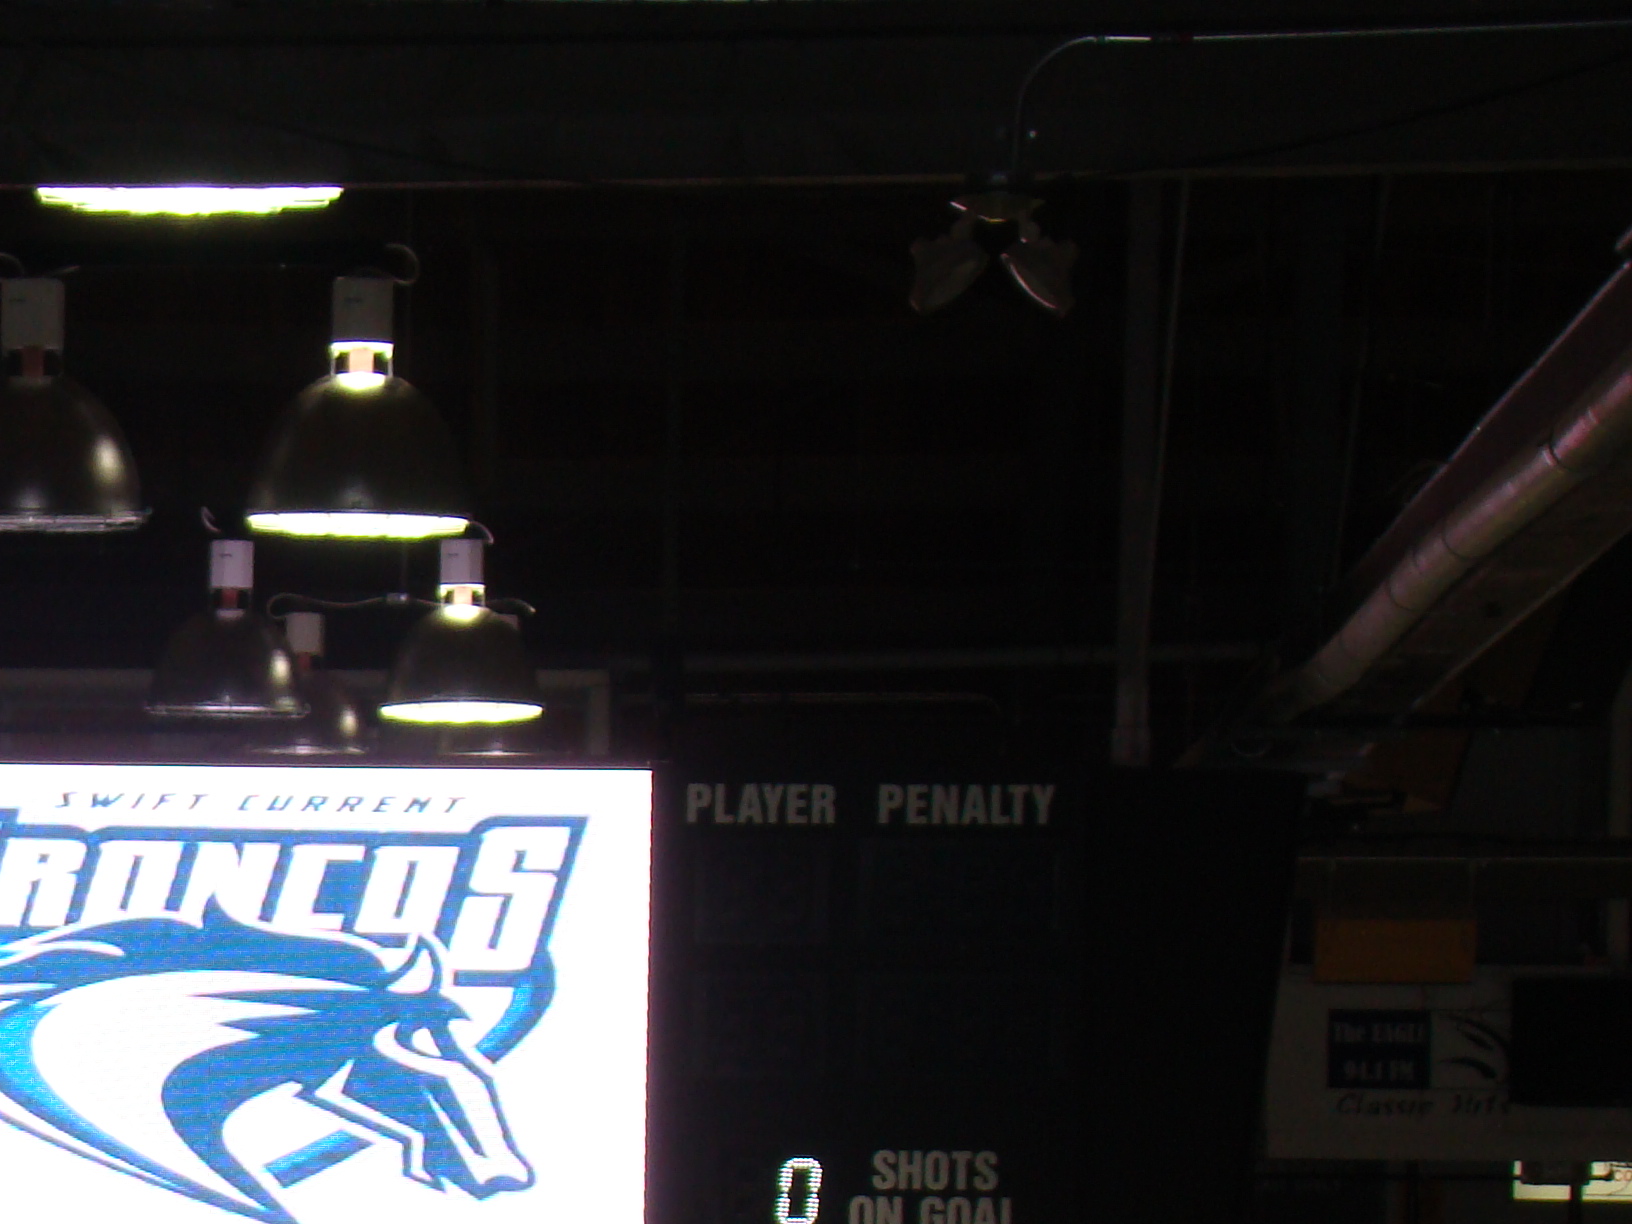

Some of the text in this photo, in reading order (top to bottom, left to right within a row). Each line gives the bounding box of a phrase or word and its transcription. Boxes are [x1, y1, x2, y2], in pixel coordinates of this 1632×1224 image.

[58, 791, 468, 815] SWIFT CURRENT
[685, 783, 1056, 825] PLAYER PENALTY
[872, 1149, 999, 1191] SHOTS
